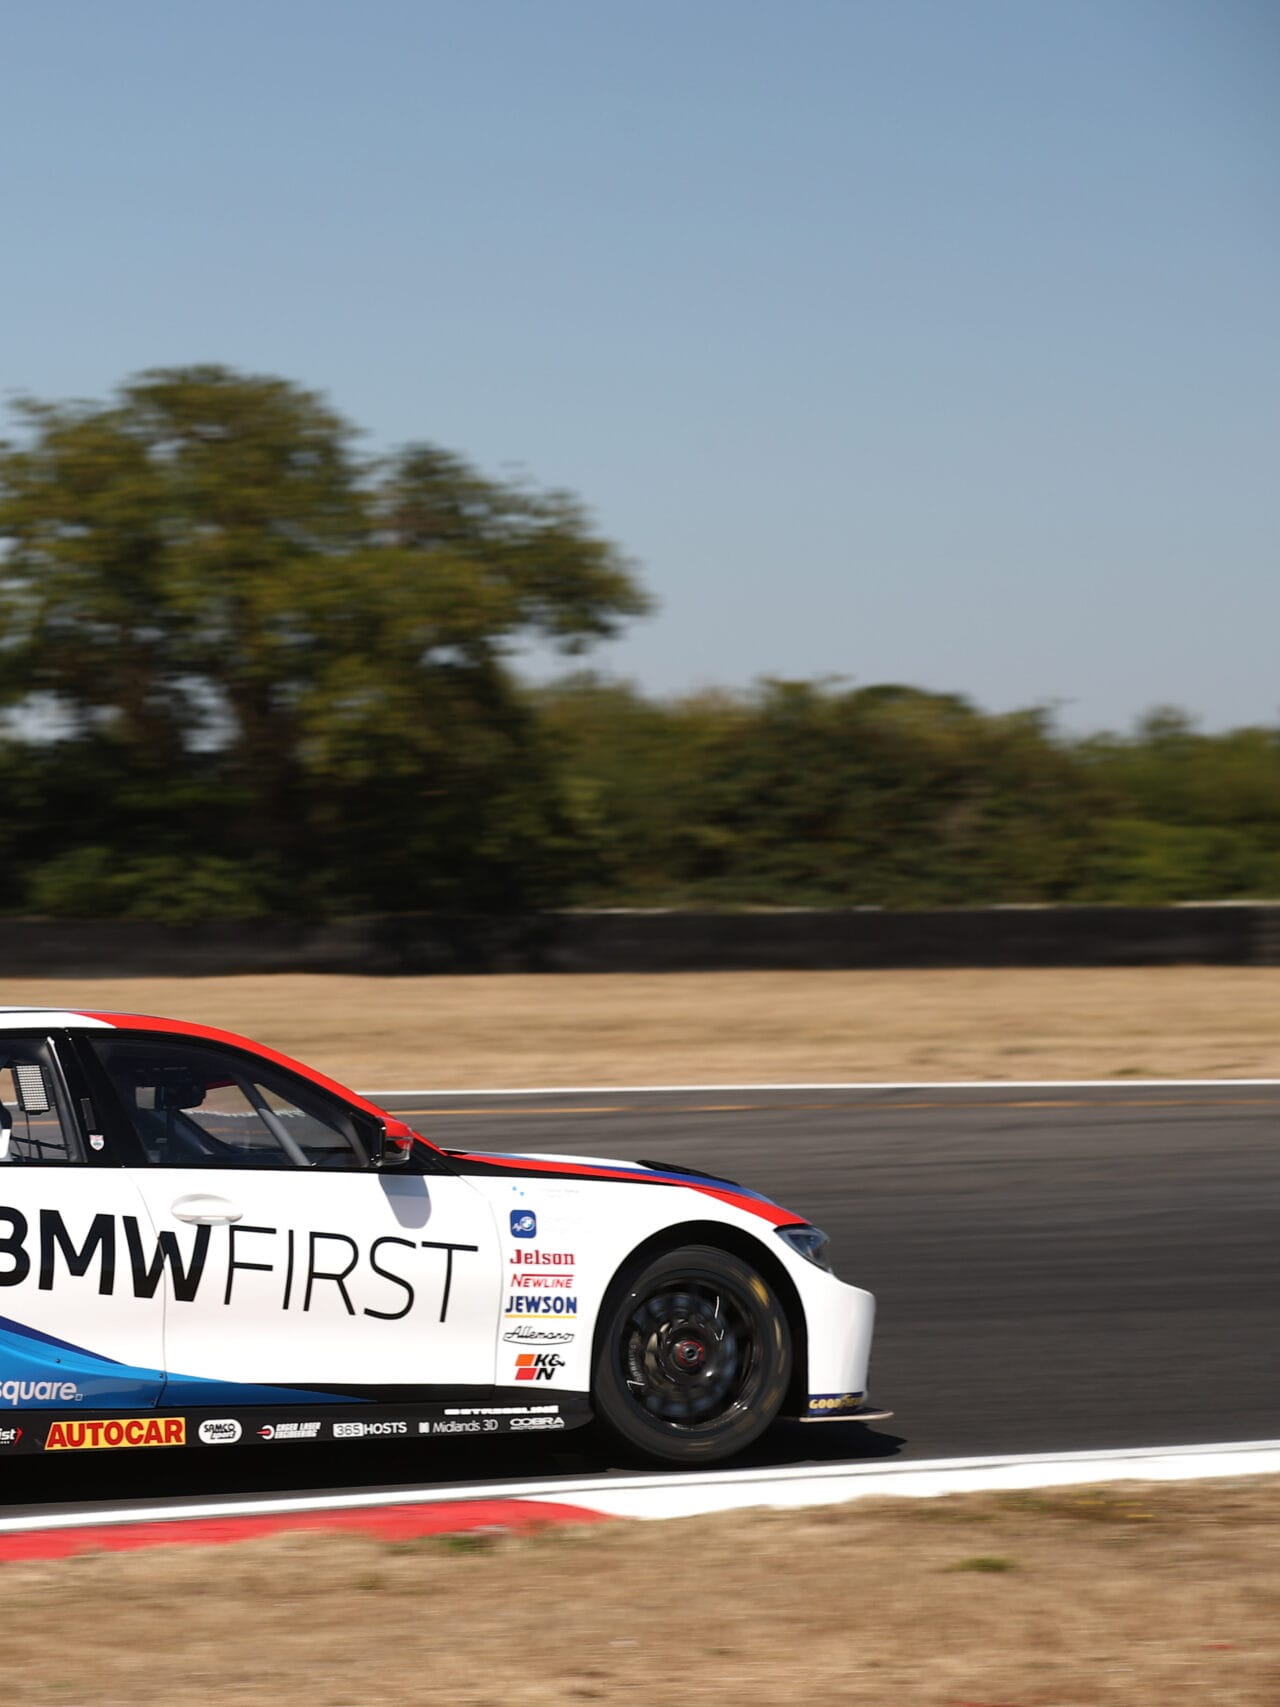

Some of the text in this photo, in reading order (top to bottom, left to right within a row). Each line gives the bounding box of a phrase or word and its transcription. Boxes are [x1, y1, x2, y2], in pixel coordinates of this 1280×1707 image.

[509, 1249, 576, 1265] Jelson
[511, 1273, 574, 1288] NEWLINE
[505, 1296, 577, 1313] JEWSON
[204, 1423, 236, 1433] SAMCO
[432, 1419, 499, 1434] Midlands 3D
[509, 1416, 566, 1426] COBRA
[46, 1419, 185, 1449] AUTOCAR
